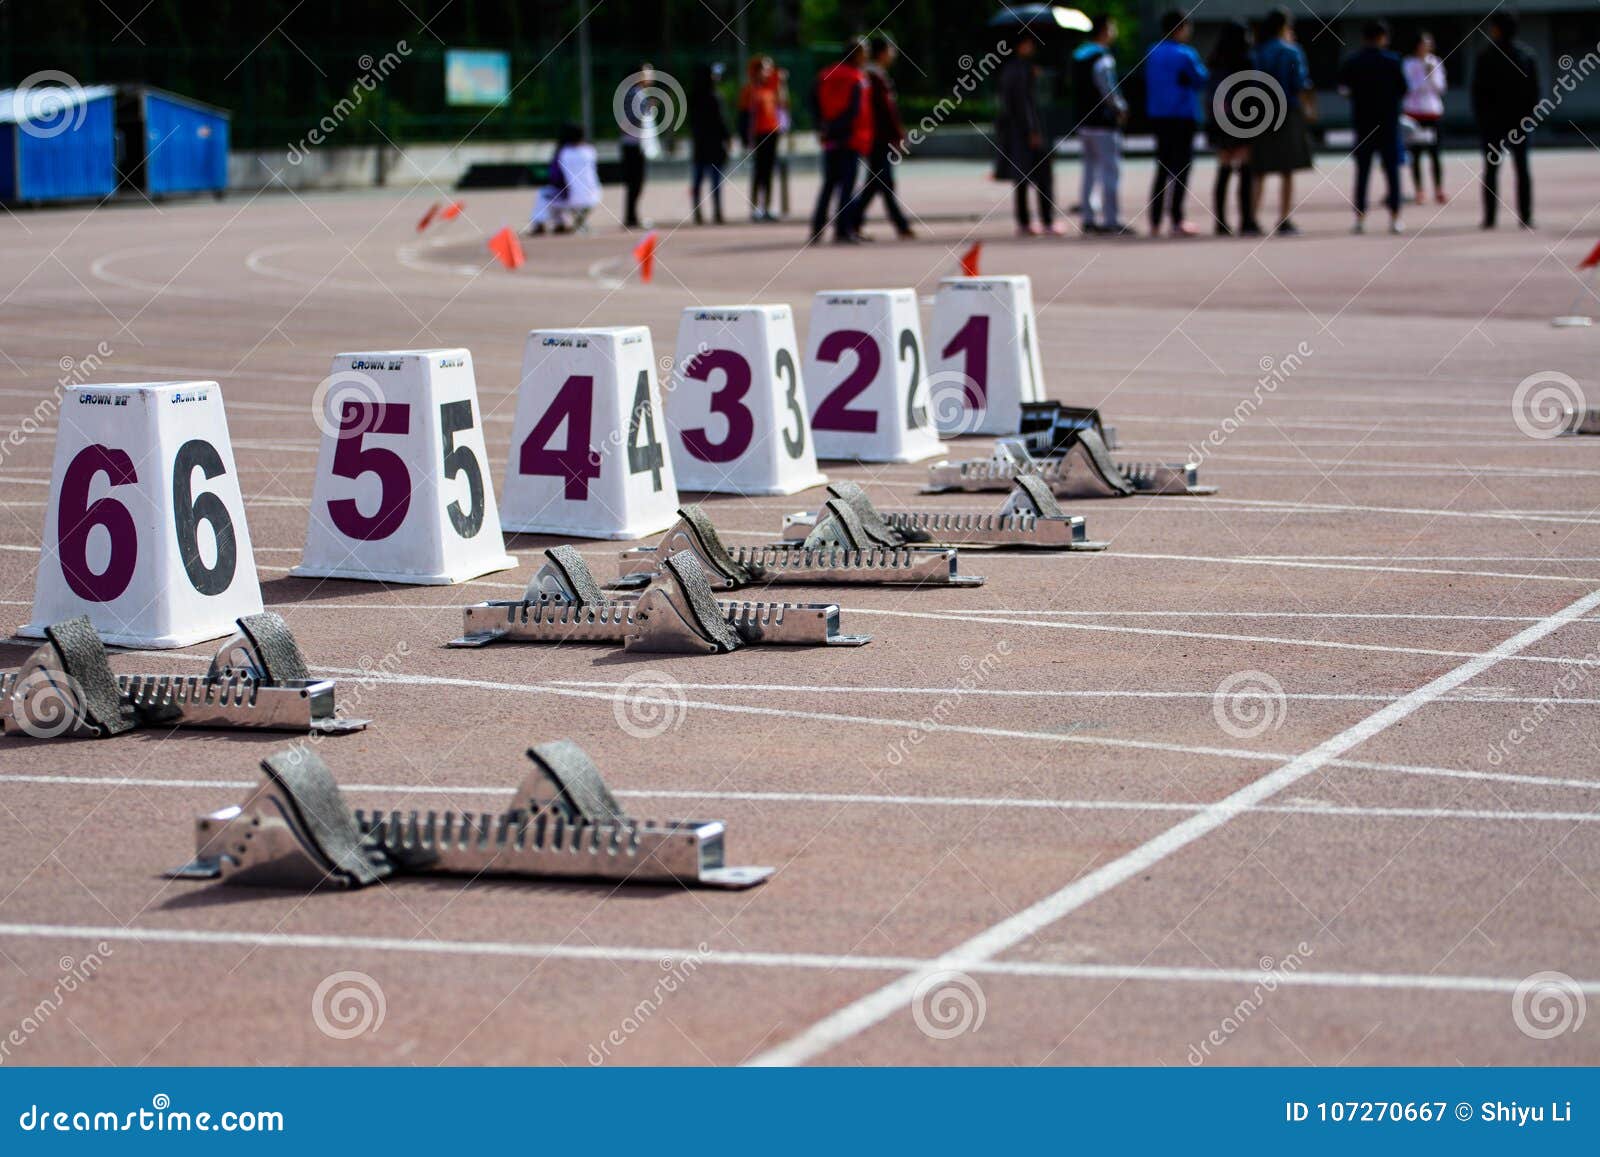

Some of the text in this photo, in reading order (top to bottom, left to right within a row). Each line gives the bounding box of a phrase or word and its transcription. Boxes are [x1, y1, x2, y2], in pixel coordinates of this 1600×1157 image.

[681, 349, 754, 463] 3
[776, 348, 805, 459] 3
[811, 329, 881, 433] 2
[900, 328, 931, 430] 2
[941, 315, 990, 410] 1
[327, 401, 412, 541] 5
[440, 399, 485, 539] 5
[519, 375, 600, 501] 4
[627, 370, 664, 493] 4
[57, 444, 139, 602] 6
[172, 439, 237, 597] 6
